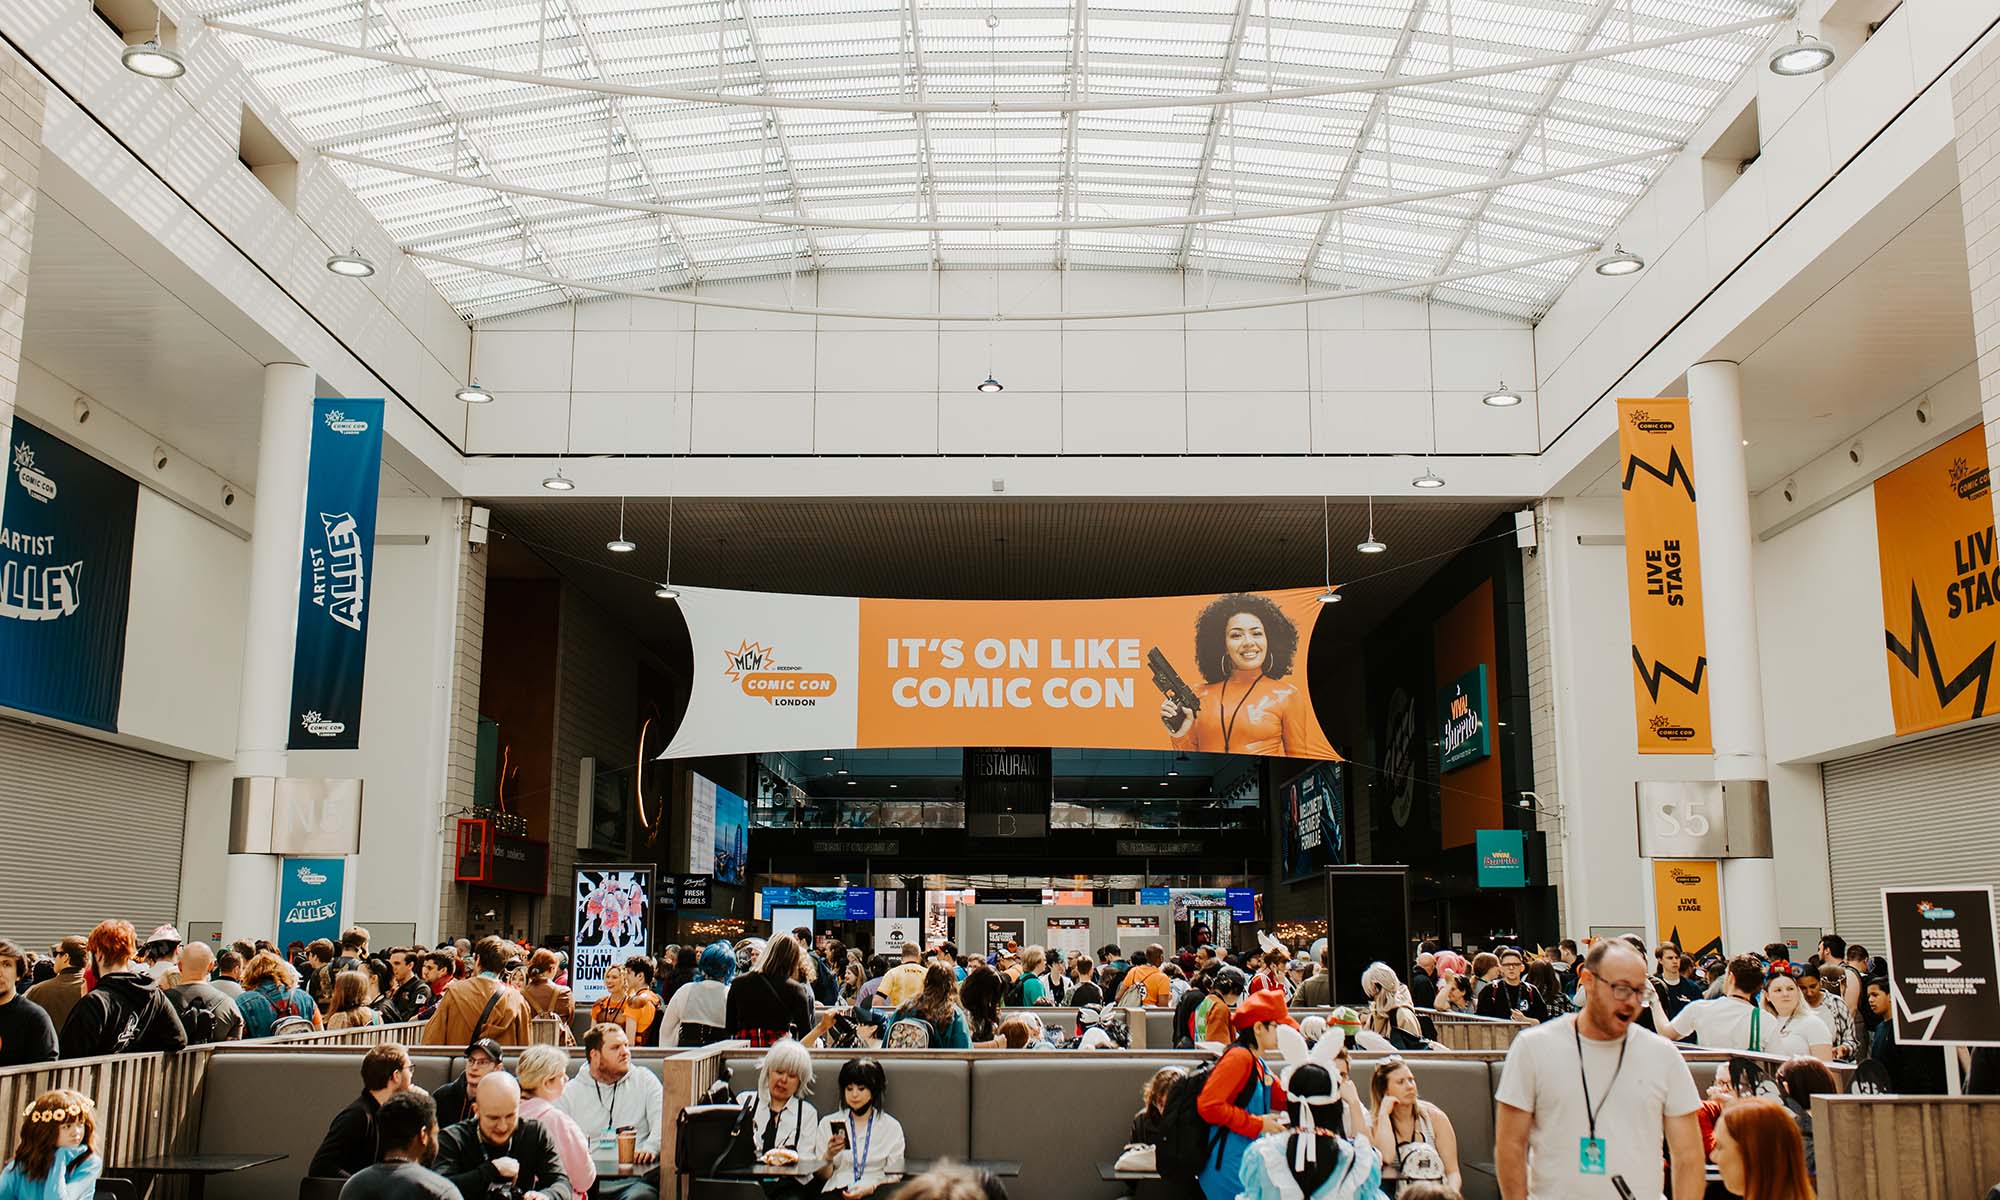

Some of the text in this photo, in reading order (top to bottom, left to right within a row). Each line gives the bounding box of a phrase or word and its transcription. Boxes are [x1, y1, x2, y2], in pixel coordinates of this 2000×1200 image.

[22, 473, 54, 494] COMIC CON
[0, 527, 54, 556] ARTIST
[1954, 525, 1997, 576] LIV
[310, 547, 326, 606] ARTIST
[320, 511, 364, 631] ALLEY
[1645, 550, 1664, 595] LIVE
[1664, 540, 1685, 606] STAGE
[0, 560, 83, 620] LLEY
[735, 650, 763, 670] MCM
[887, 638, 1141, 669] IT'S ON LIKE
[747, 680, 831, 690] COMIC CON
[892, 677, 1135, 708] COMIC CON
[1656, 800, 1709, 839] S5
[285, 902, 337, 923] ALLEY
[296, 898, 322, 907] ARTIST
[1921, 929, 1959, 938] PRESS
[1921, 939, 1961, 948] OFFICE
[576, 954, 612, 968] SLAM
